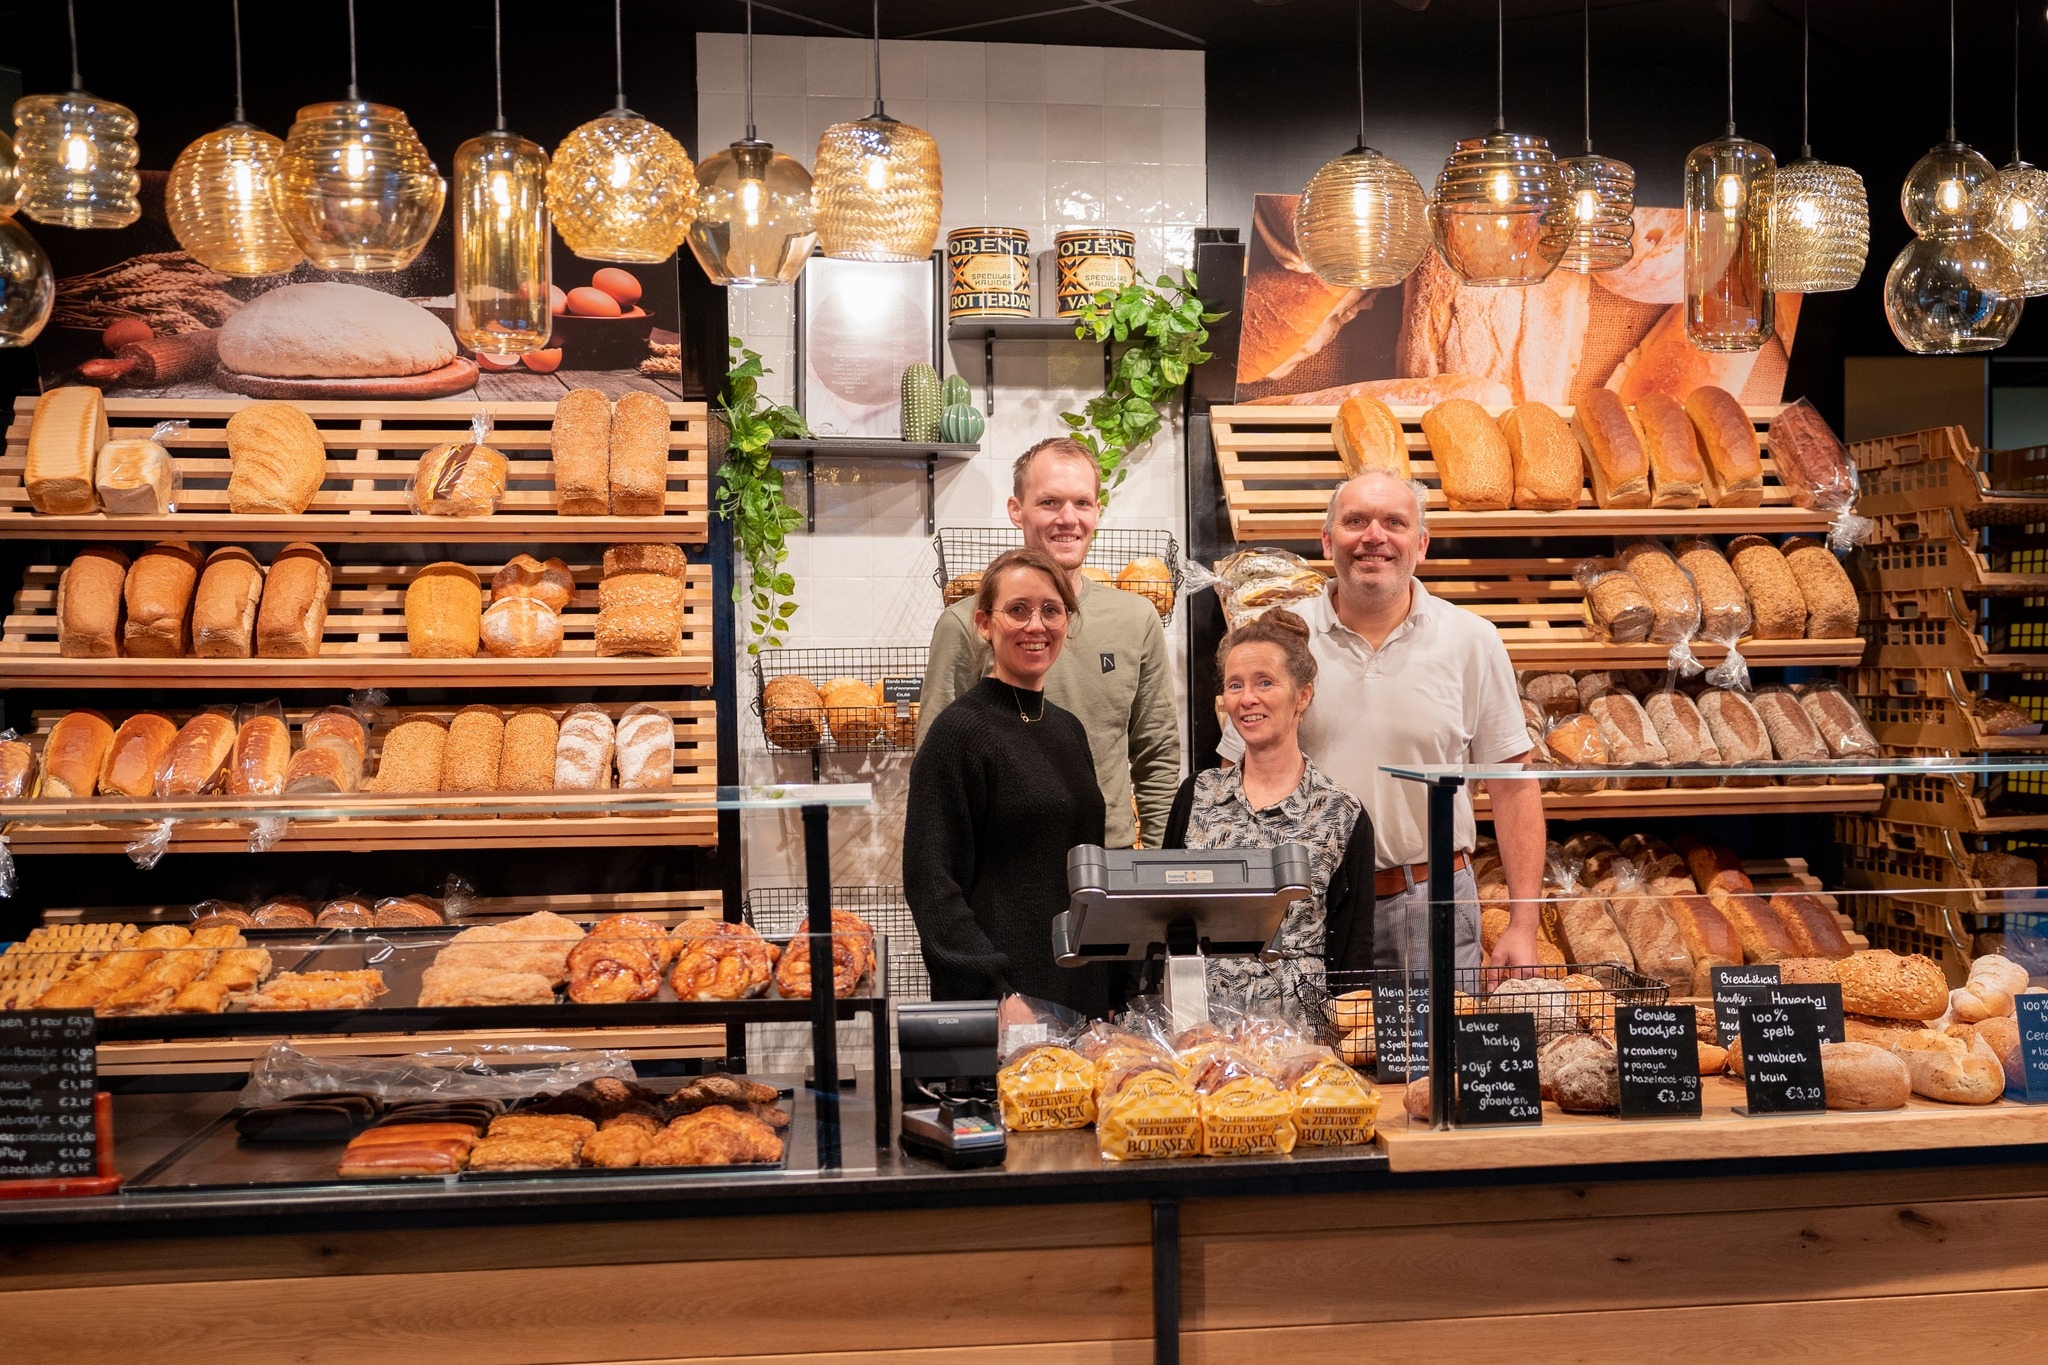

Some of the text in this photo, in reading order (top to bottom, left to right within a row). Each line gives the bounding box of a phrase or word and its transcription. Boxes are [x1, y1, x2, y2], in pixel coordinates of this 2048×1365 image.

[1088, 280, 1124, 288] KRUID
[1720, 972, 1778, 985] Breadsticks
[1378, 986, 1404, 997] Klein
[1634, 1008, 1677, 1021] Gevulde
[1400, 1027, 1423, 1037] buin
[1459, 1018, 1499, 1032] Lekker
[1629, 1023, 1685, 1039] broodjes
[1763, 1025, 1794, 1040] spelt
[1482, 1035, 1520, 1052] hartig
[1630, 1046, 1678, 1059] cranberry
[1469, 1060, 1492, 1078] Olijf
[1631, 1062, 1667, 1074] papaya
[1760, 1072, 1788, 1082] bruin
[1470, 1080, 1516, 1098] Gegrilde
[1785, 1086, 1821, 1100] €3,20
[1028, 1094, 1075, 1107] ZEEUWSE
[1479, 1096, 1528, 1111] groenten
[1021, 1105, 1084, 1128] BOLUSSEN
[1311, 1116, 1360, 1126] ZEEUWSE
[1136, 1125, 1187, 1136] ZEEUWSE
[1302, 1128, 1369, 1147] BOLUSSEN
[1126, 1139, 1195, 1158] BOLUSSEN
[1209, 1135, 1277, 1155] BOLUSSEN
